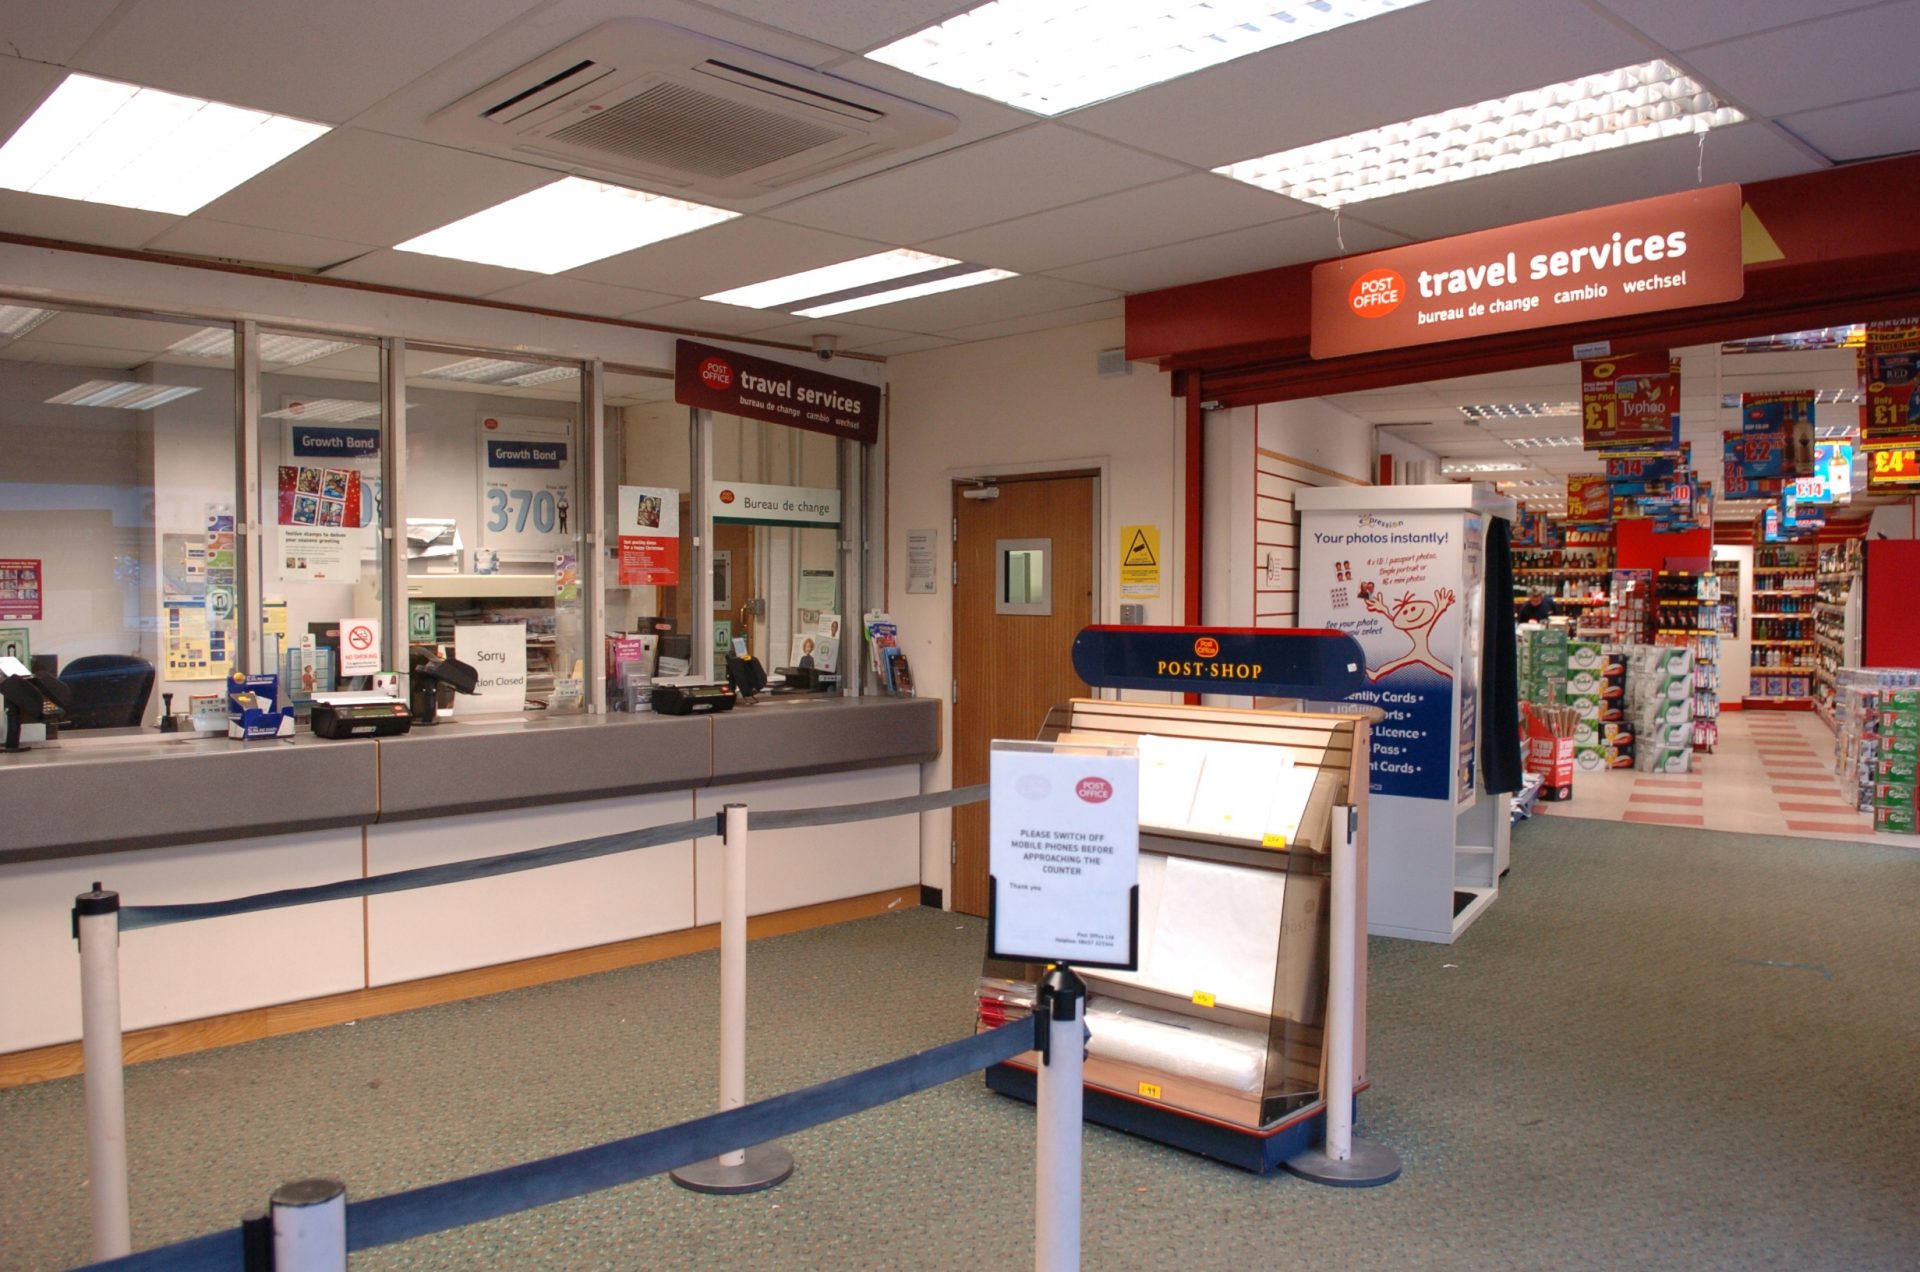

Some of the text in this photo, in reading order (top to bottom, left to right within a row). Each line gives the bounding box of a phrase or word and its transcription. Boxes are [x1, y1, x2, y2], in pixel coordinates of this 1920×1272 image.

[1418, 231, 1687, 298] travel services
[1361, 275, 1393, 293] POST
[1353, 289, 1398, 309] OFFICE
[1418, 271, 1687, 325] bureau de change cambio wechsel
[707, 362, 727, 374] POST
[702, 371, 729, 384] OFFICE
[740, 371, 861, 414] travel services
[739, 396, 860, 430] bureau de change cambio wechsel
[1621, 400, 1666, 417] Typhoo
[1586, 402, 1616, 430] £1
[302, 435, 374, 449] Growth Bond
[496, 448, 557, 460] Growth Bond
[744, 497, 778, 510] Bureau
[783, 500, 795, 511] de
[798, 501, 830, 516] change
[1314, 532, 1448, 545] Your photos instantly!
[1389, 554, 1415, 566] passport
[1326, 619, 1378, 630] See your photo
[1362, 627, 1383, 636] select
[477, 651, 506, 663] Sorry
[496, 676, 524, 687] Closed
[1382, 691, 1416, 704] Cards
[1375, 726, 1420, 739] Licence
[1373, 743, 1400, 755] Pass
[1380, 762, 1414, 773] Cards
[1082, 781, 1105, 790] POST
[1078, 788, 1109, 799] OFFICE
[1020, 829, 1105, 842] PLEASE SWITCH OFF
[1011, 840, 1114, 855] MOBILE PHONES BEFORE
[1023, 853, 1101, 866] APPROACHING THE
[1042, 865, 1082, 875] COUNTER
[1010, 882, 1042, 892] Thank you
